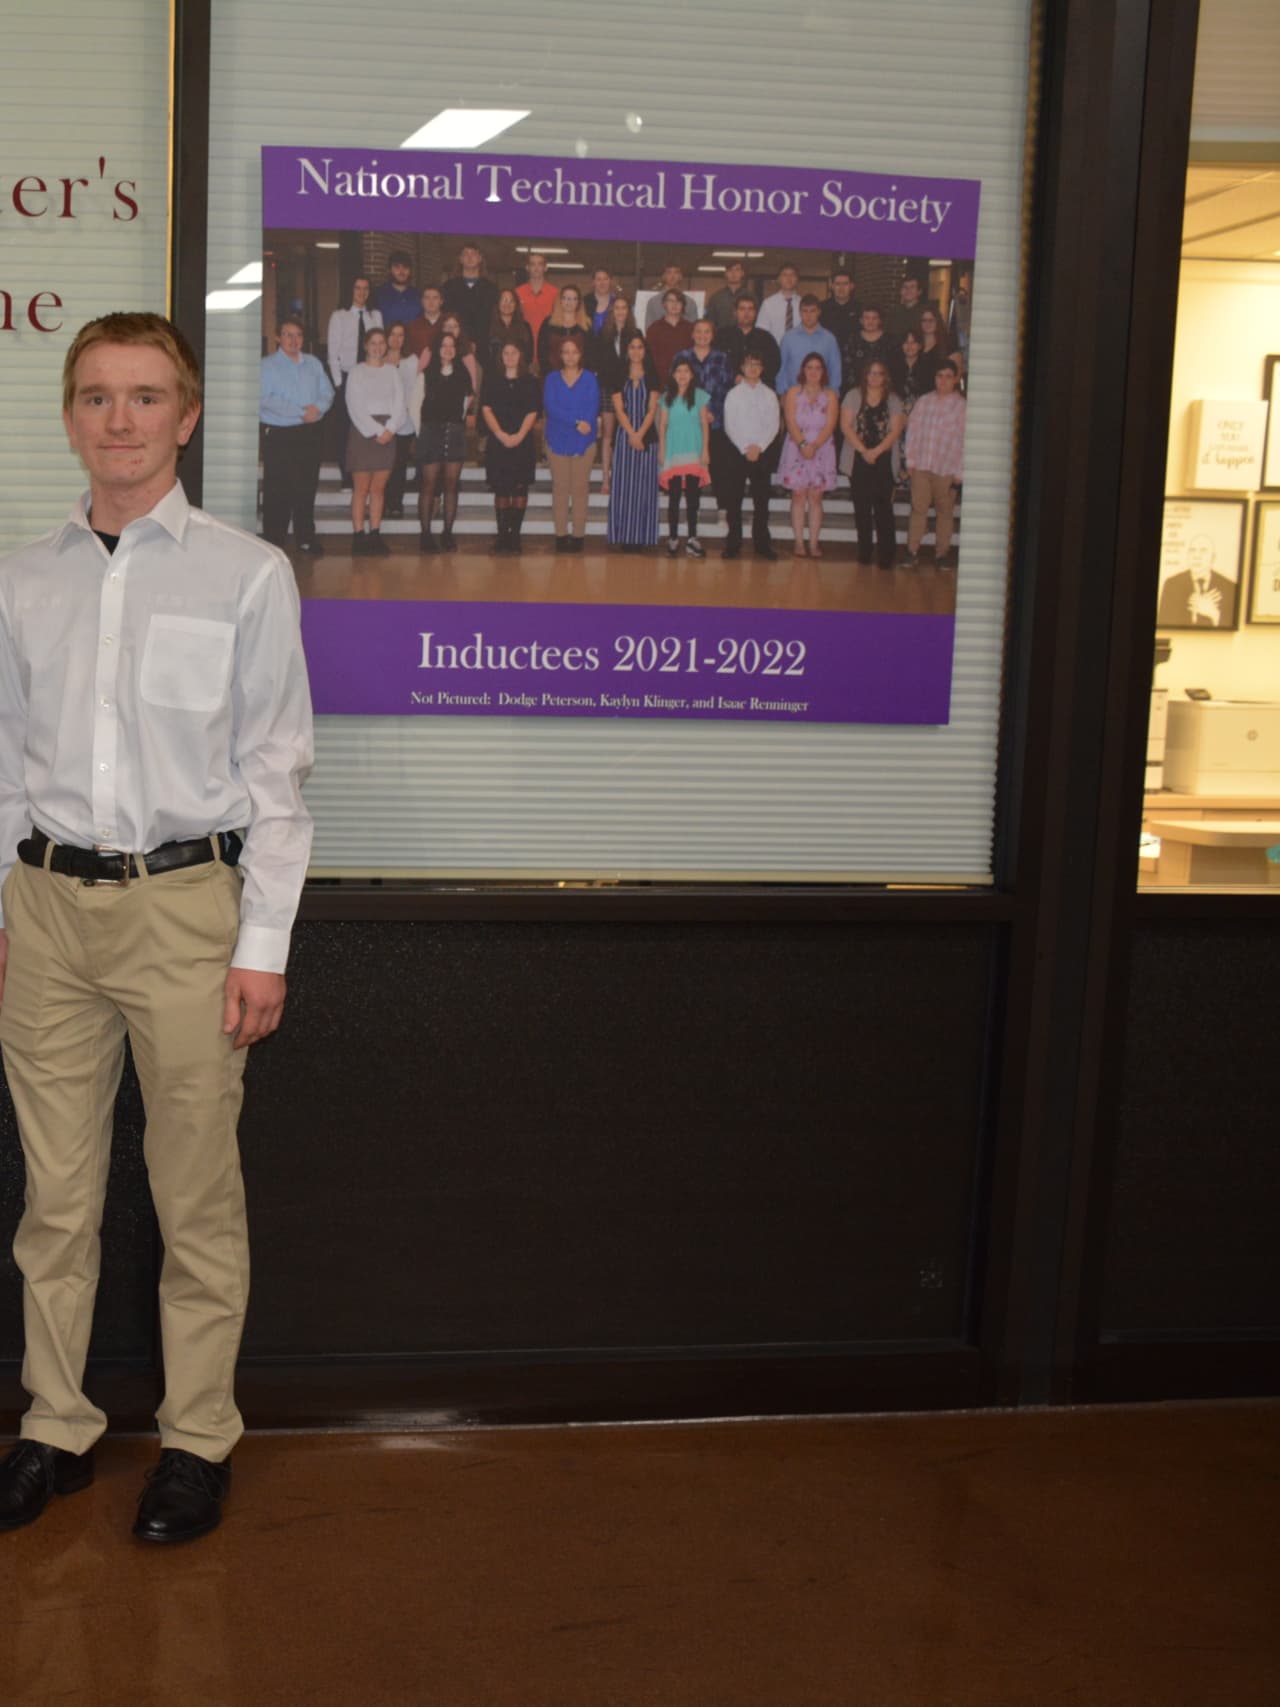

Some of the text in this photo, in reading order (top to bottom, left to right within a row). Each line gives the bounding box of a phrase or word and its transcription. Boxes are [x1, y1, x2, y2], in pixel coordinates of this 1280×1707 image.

[296, 156, 951, 233] National Technical Honor Society
[418, 632, 806, 676] Inductees 2021-2022
[410, 691, 433, 704] Not
[437, 692, 491, 705] Pictured:
[498, 692, 538, 708] Dodge
[692, 696, 715, 709] and
[717, 696, 747, 710] Isaac
